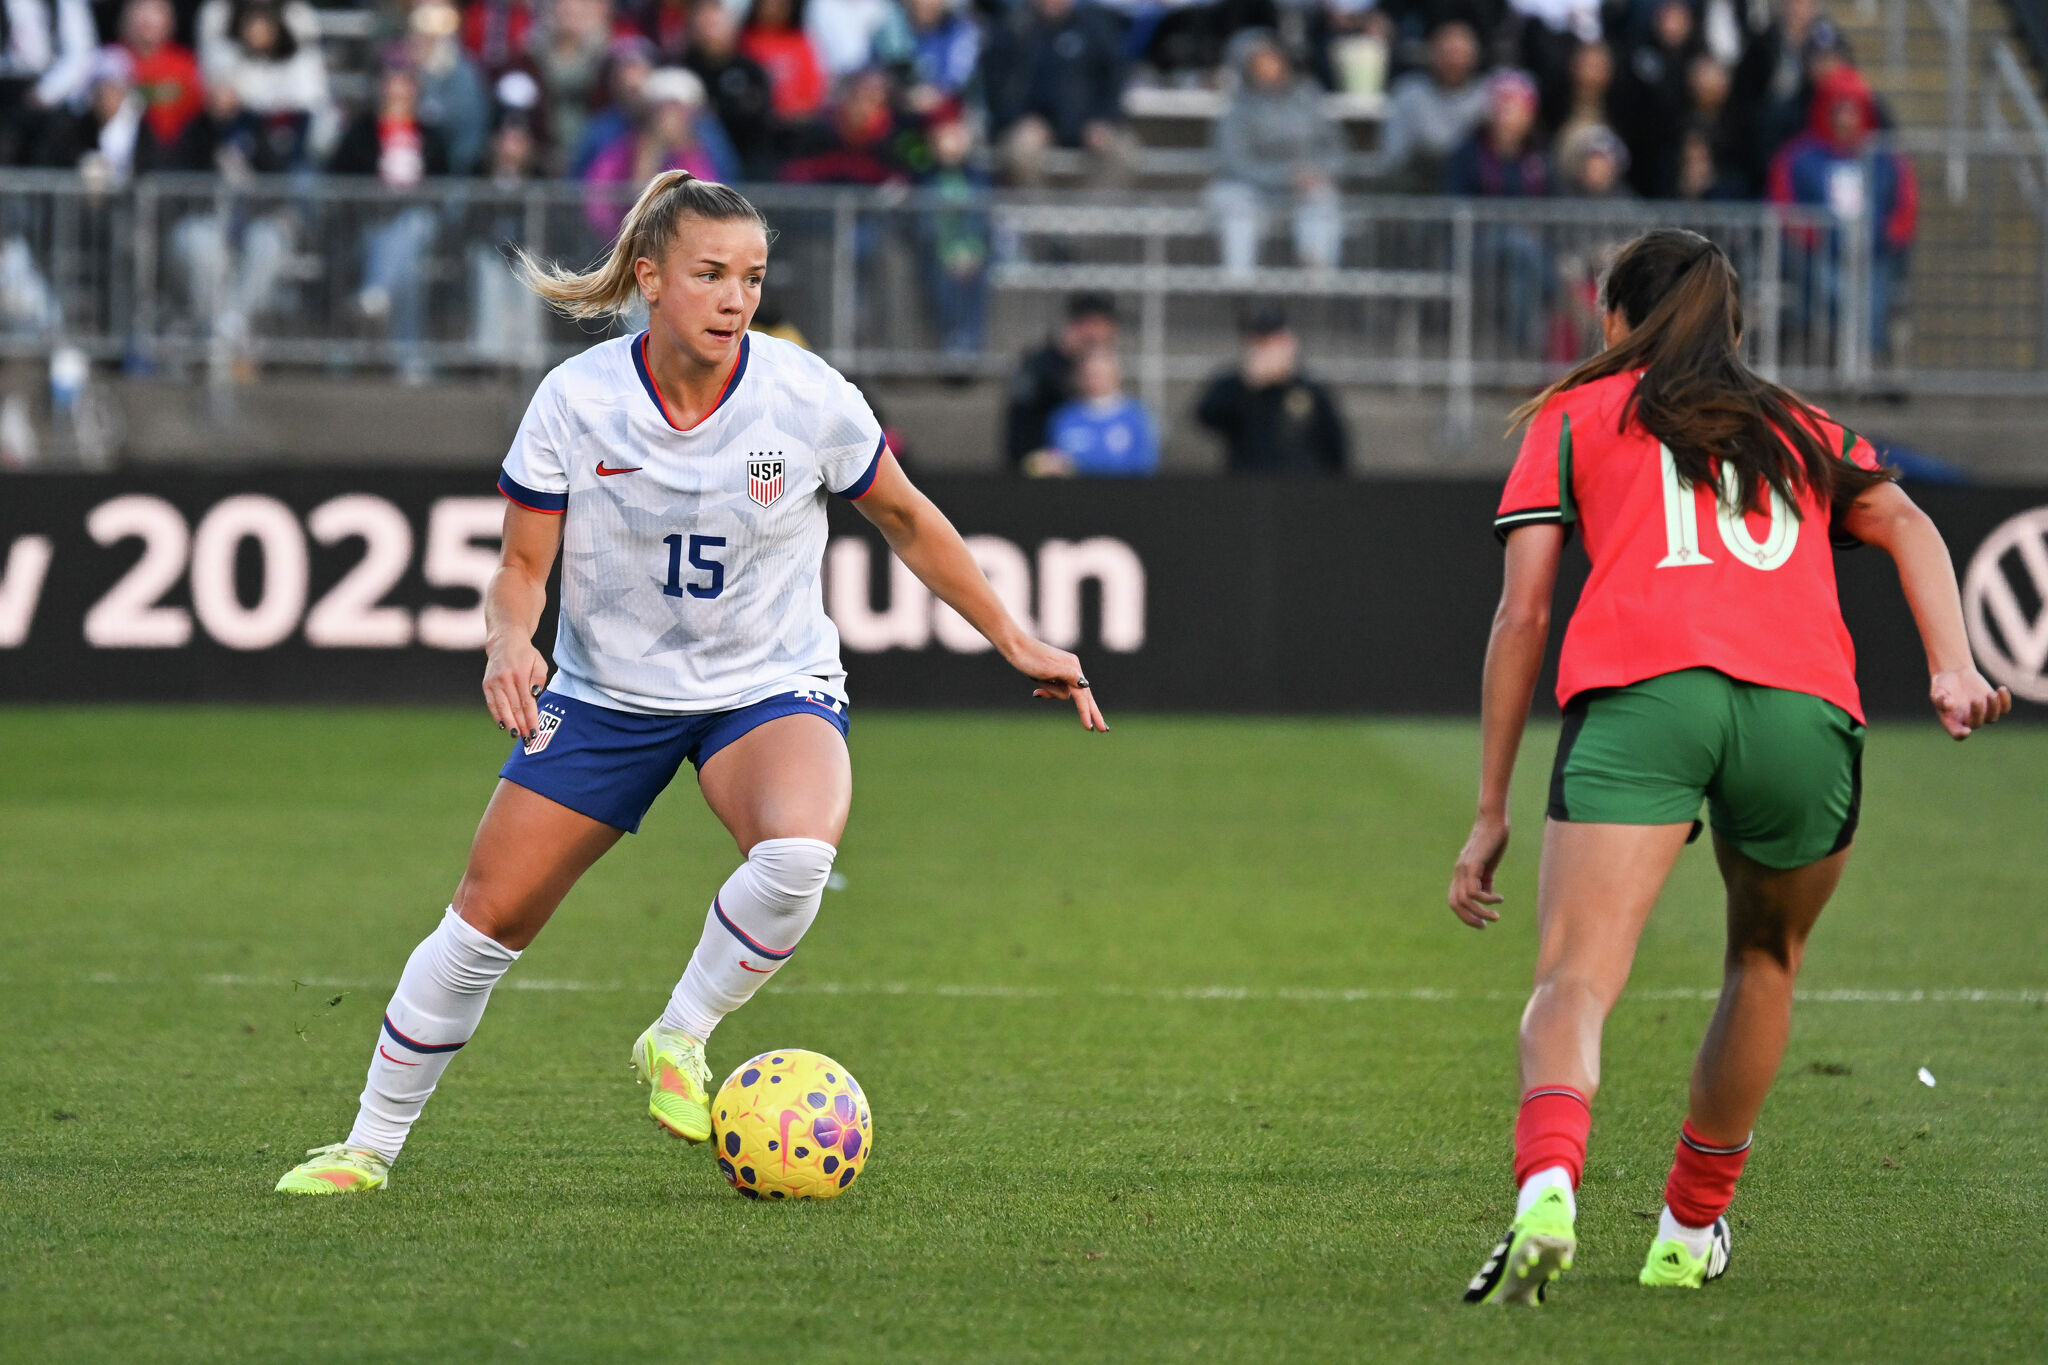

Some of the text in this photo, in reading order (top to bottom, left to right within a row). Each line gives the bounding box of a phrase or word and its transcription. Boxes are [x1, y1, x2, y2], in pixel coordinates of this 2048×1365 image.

[750, 462, 782, 481] USA
[1655, 440, 1801, 571] 10
[84, 493, 503, 650] 2025
[662, 533, 727, 600] 15
